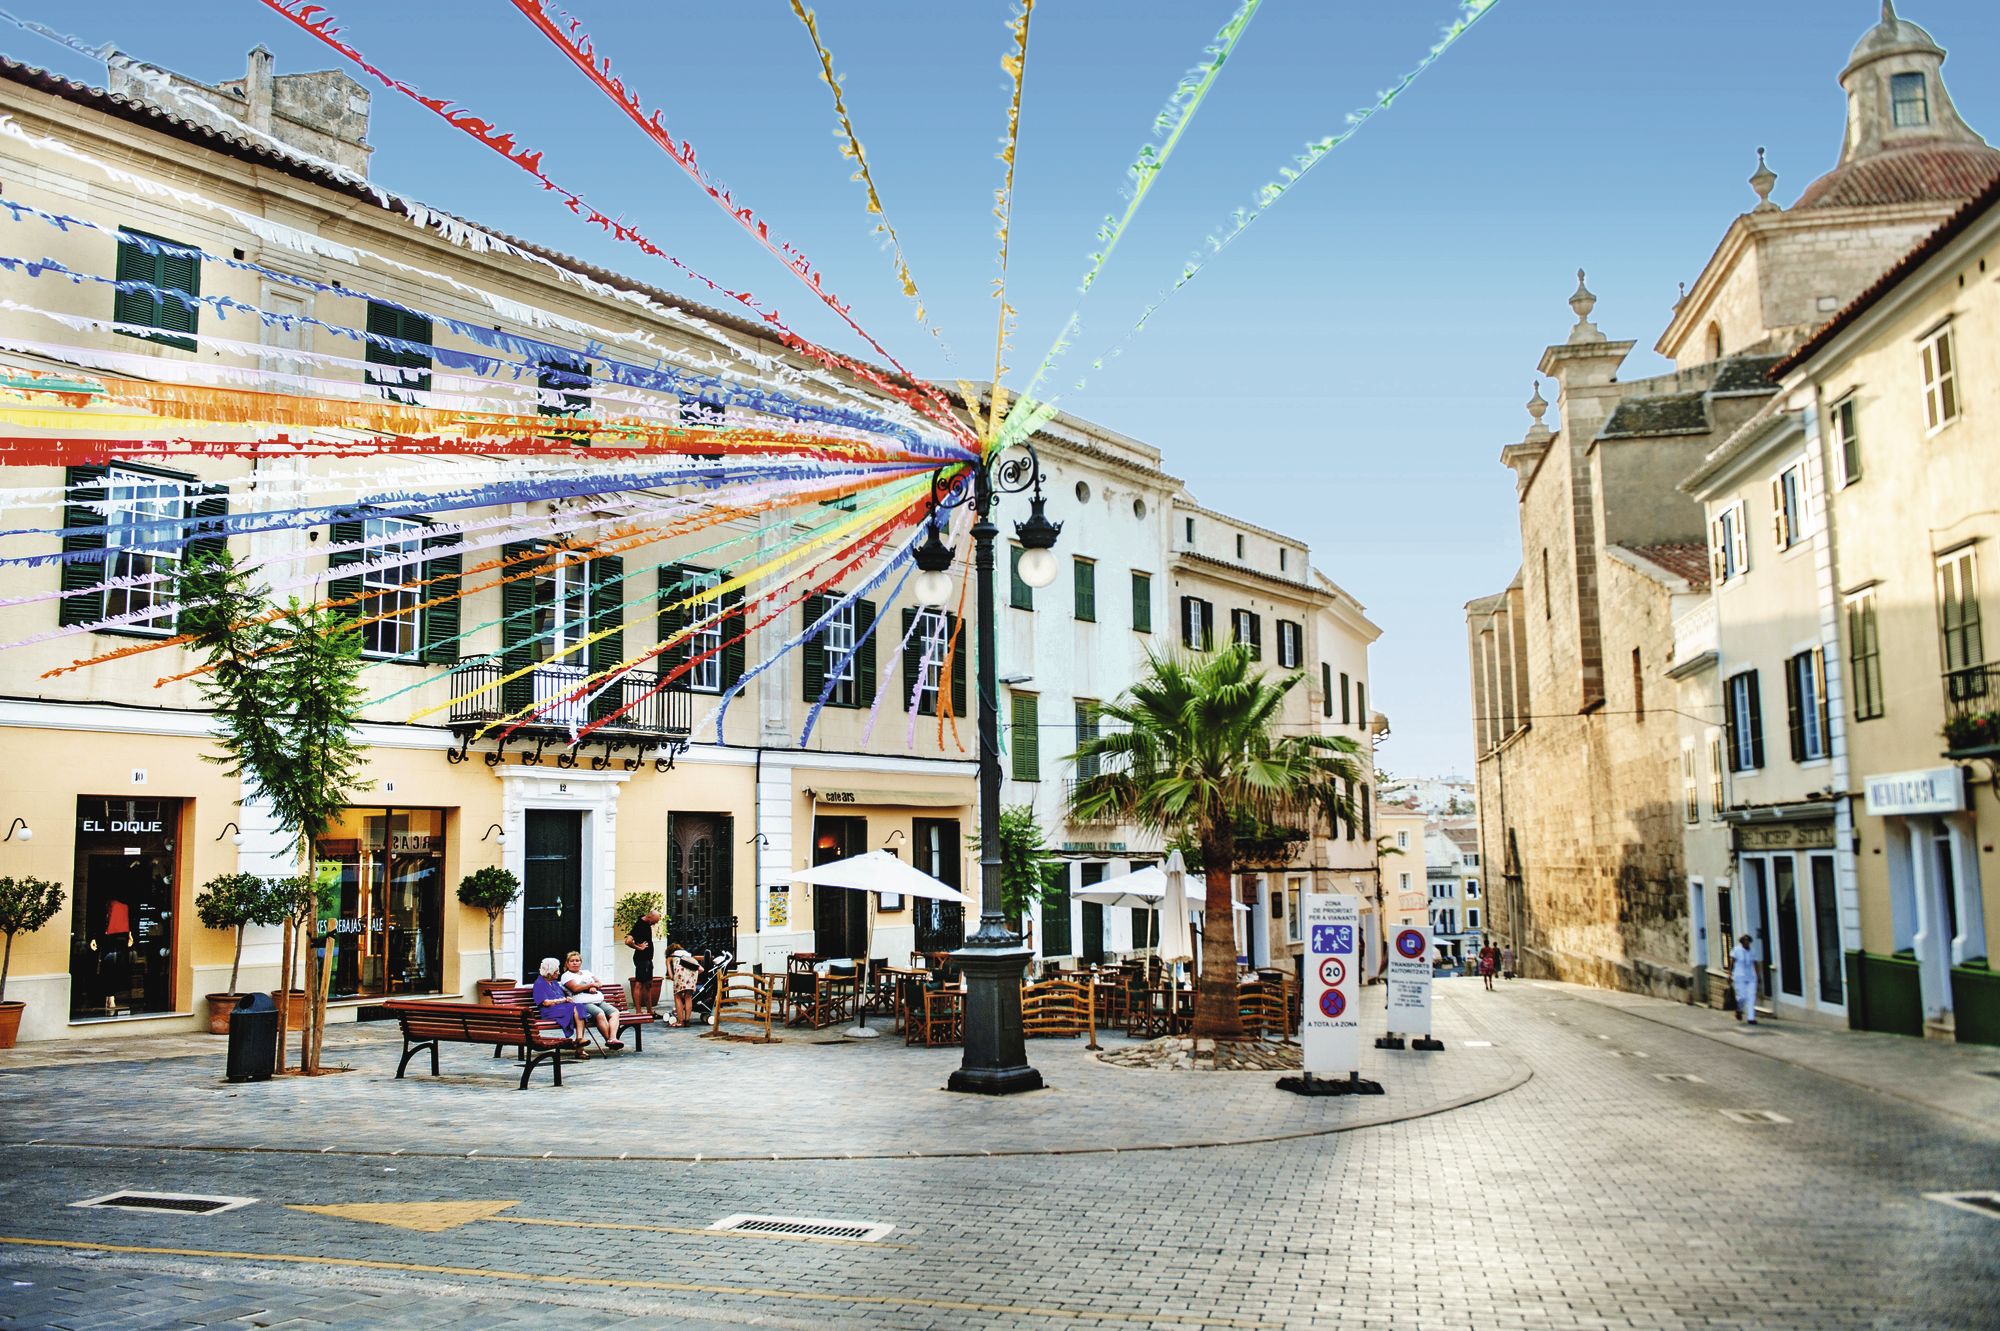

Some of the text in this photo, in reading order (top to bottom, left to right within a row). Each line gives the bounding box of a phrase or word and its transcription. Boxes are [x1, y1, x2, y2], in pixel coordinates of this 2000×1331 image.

[135, 772, 144, 782] 10
[387, 782, 393, 791] 11
[560, 784, 567, 792] 12
[842, 792, 855, 802] ars
[83, 821, 162, 834] EL DIQUE
[371, 918, 383, 932] ALE
[1325, 967, 1340, 977] 20
